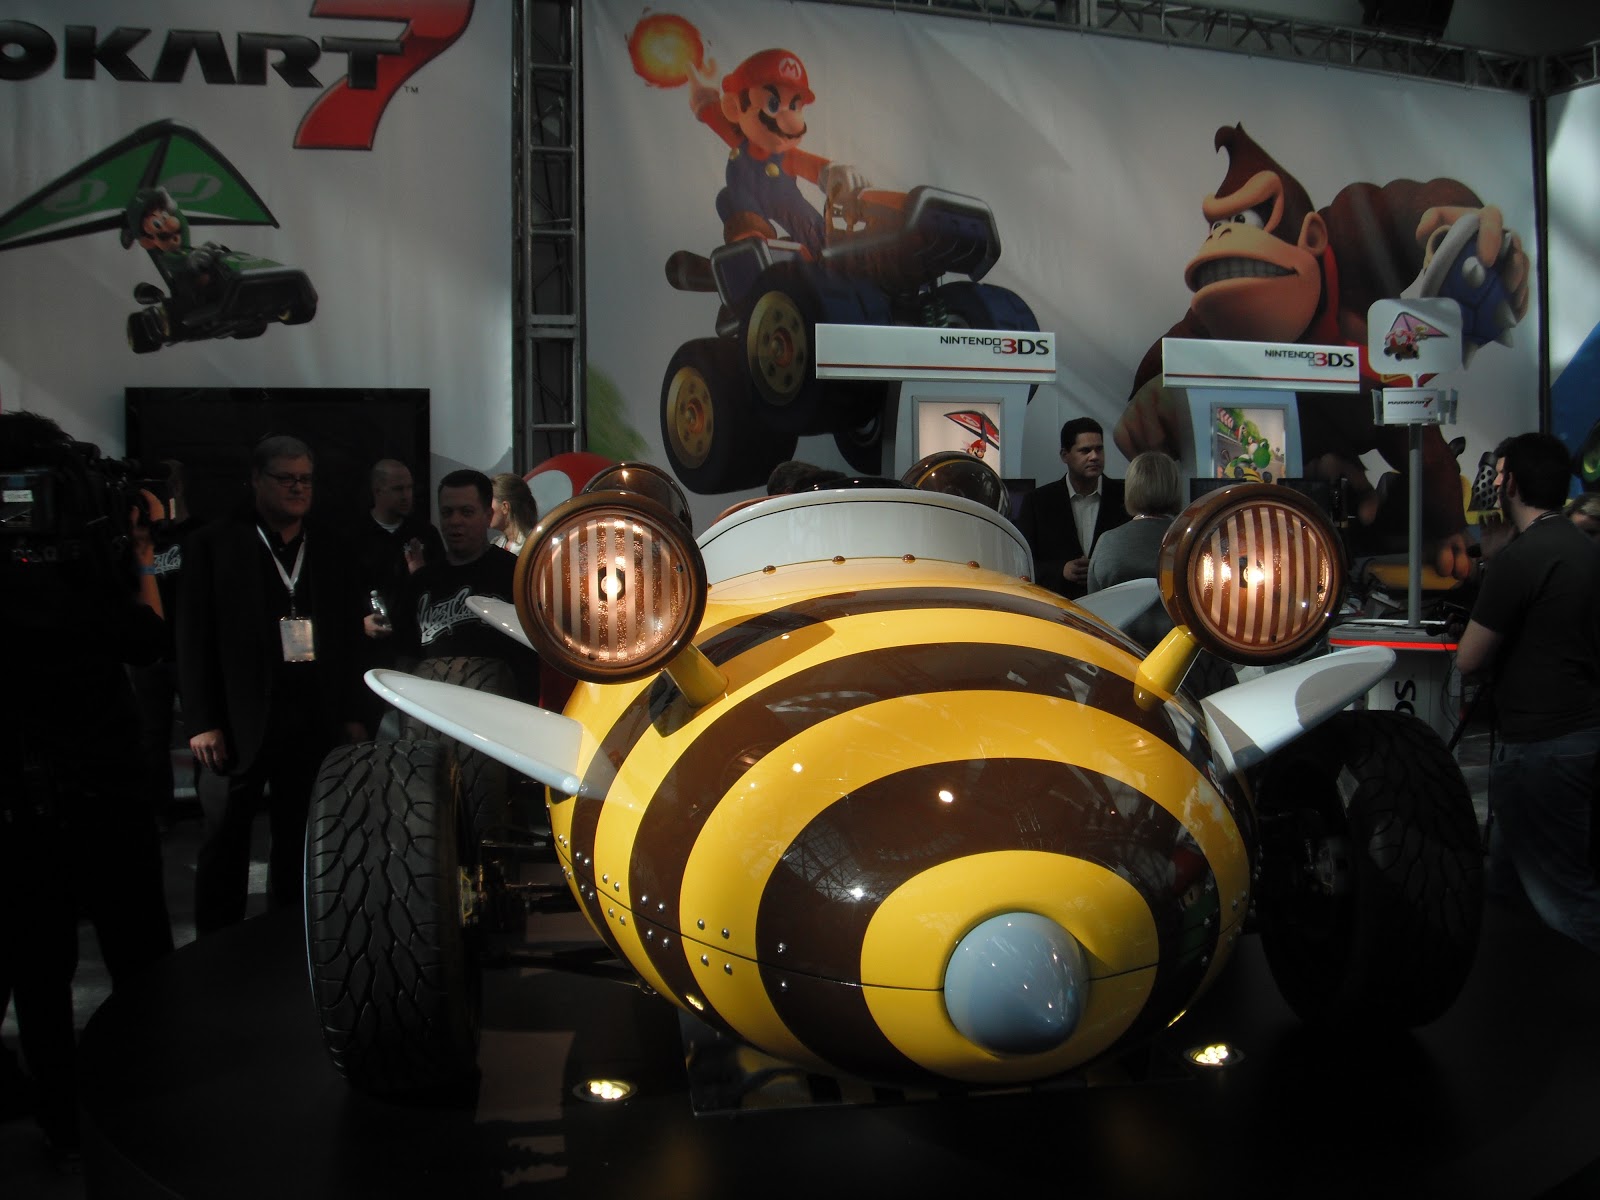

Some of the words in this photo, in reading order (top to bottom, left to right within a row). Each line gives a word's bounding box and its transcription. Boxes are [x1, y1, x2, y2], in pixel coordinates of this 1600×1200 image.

[940, 335, 1001, 346] NINTENDO
[1001, 338, 1049, 355] 3DS
[1314, 352, 1354, 368] 3DS
